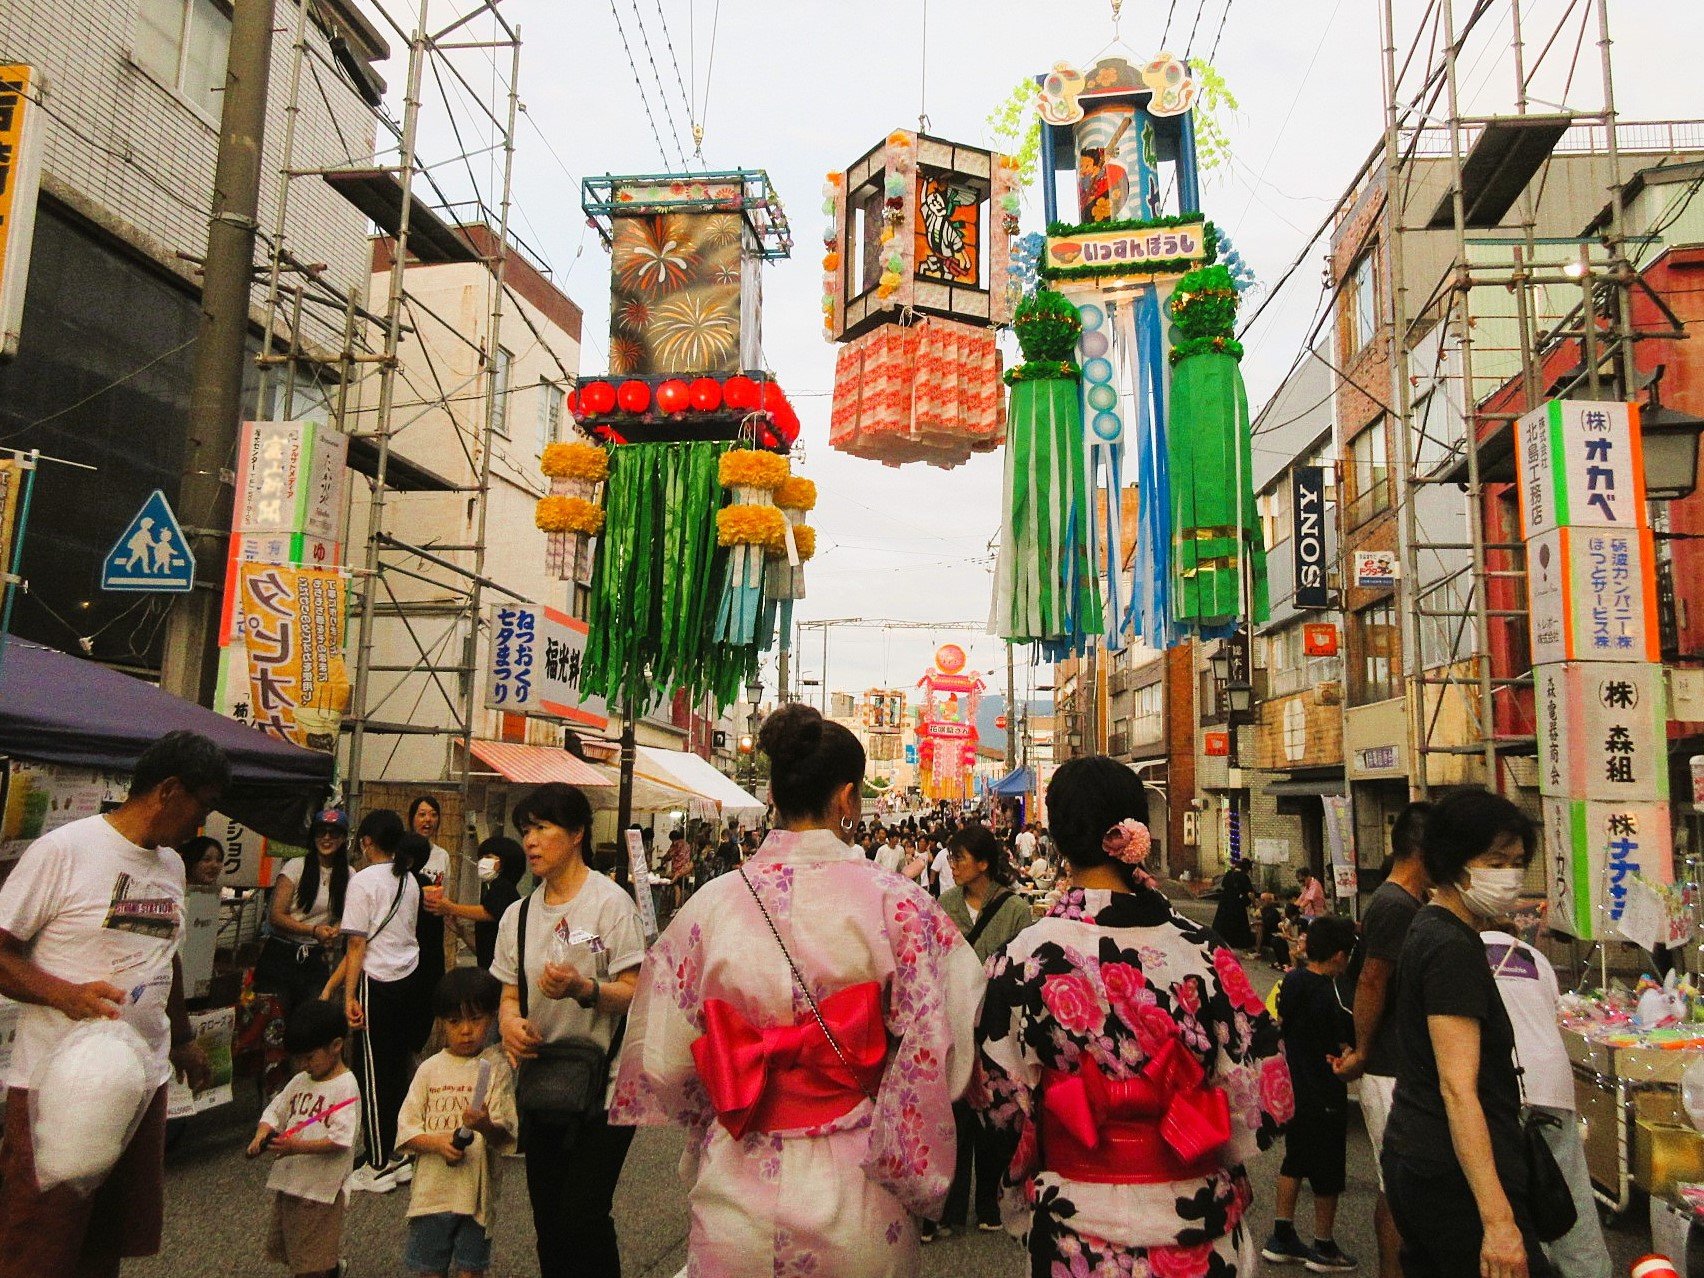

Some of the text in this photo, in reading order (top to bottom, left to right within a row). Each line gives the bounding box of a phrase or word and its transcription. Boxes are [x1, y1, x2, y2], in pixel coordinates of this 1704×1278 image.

[1083, 233, 1195, 262] いっすんぼうし
[1300, 483, 1321, 588] SONY
[493, 608, 516, 704] 七夕まつり
[514, 610, 535, 703] ねつおくり
